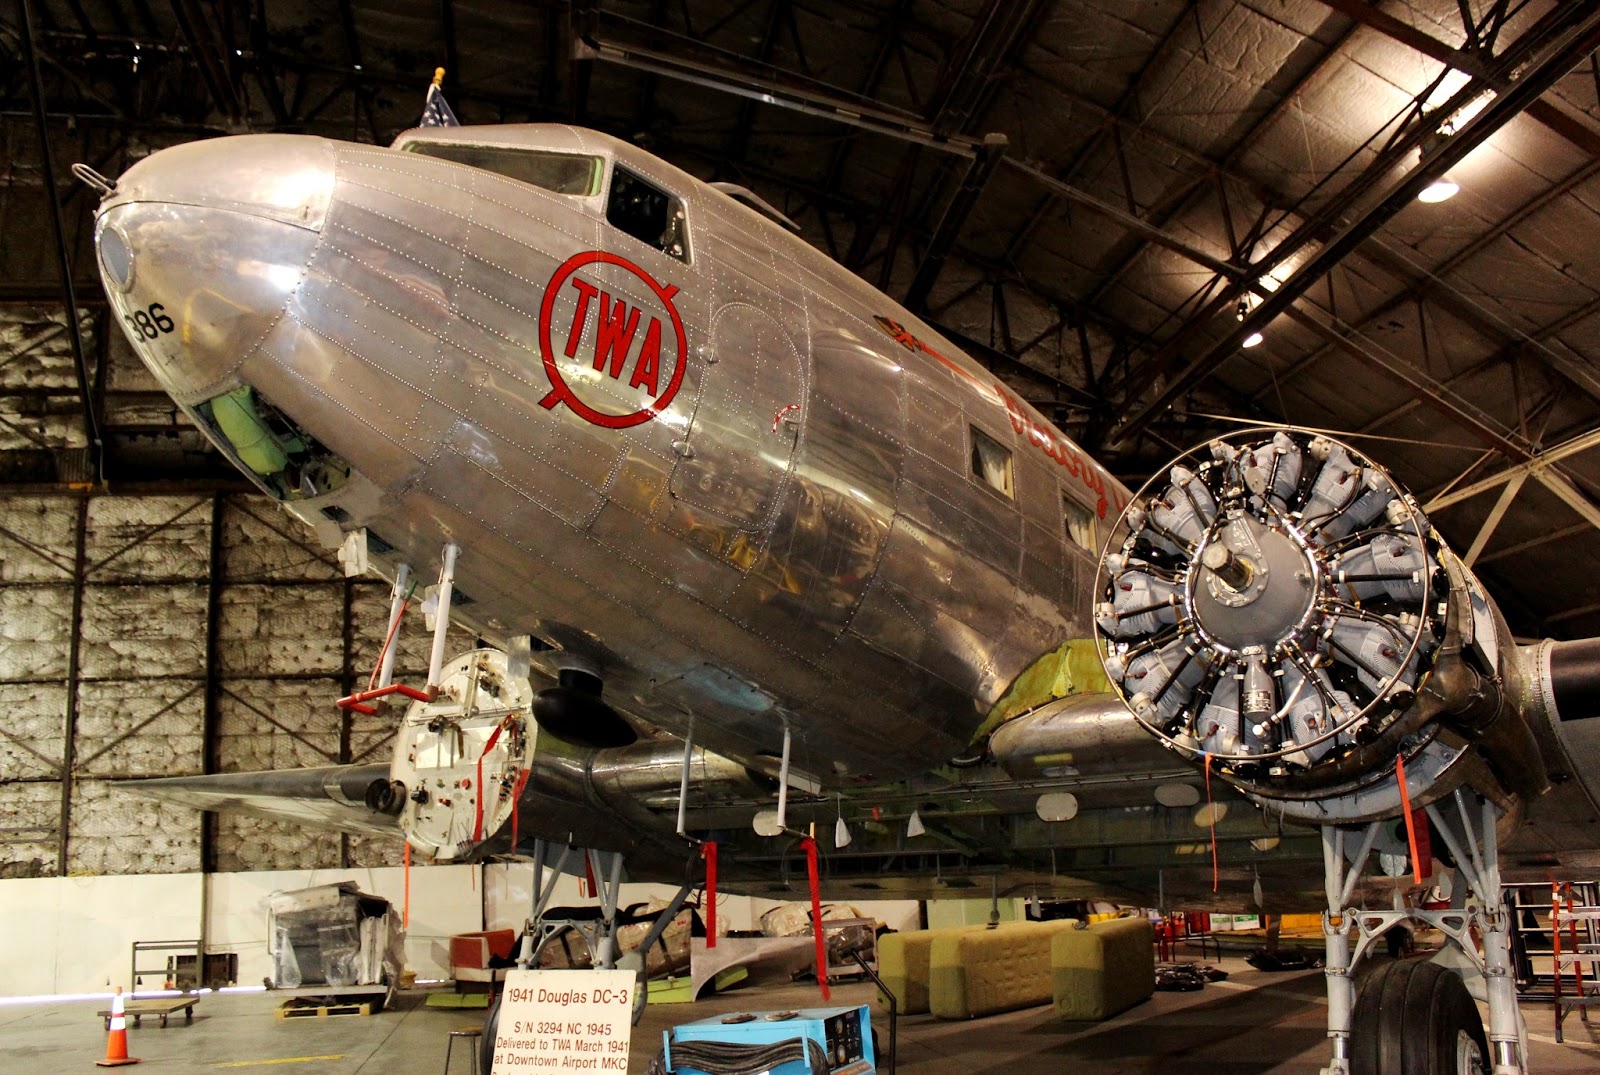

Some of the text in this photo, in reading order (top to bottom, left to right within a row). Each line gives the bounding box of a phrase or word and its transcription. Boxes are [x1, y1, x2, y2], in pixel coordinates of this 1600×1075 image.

[125, 303, 175, 343] 386
[564, 277, 662, 398] TWA
[508, 988, 628, 1006] 1941 Douglas DC-3
[514, 1021, 612, 1036] S/N 3294 NC 1945
[496, 1036, 628, 1053] Delivered to TWA March 1941
[494, 1053, 627, 1071] at Downtown Airport MKC
